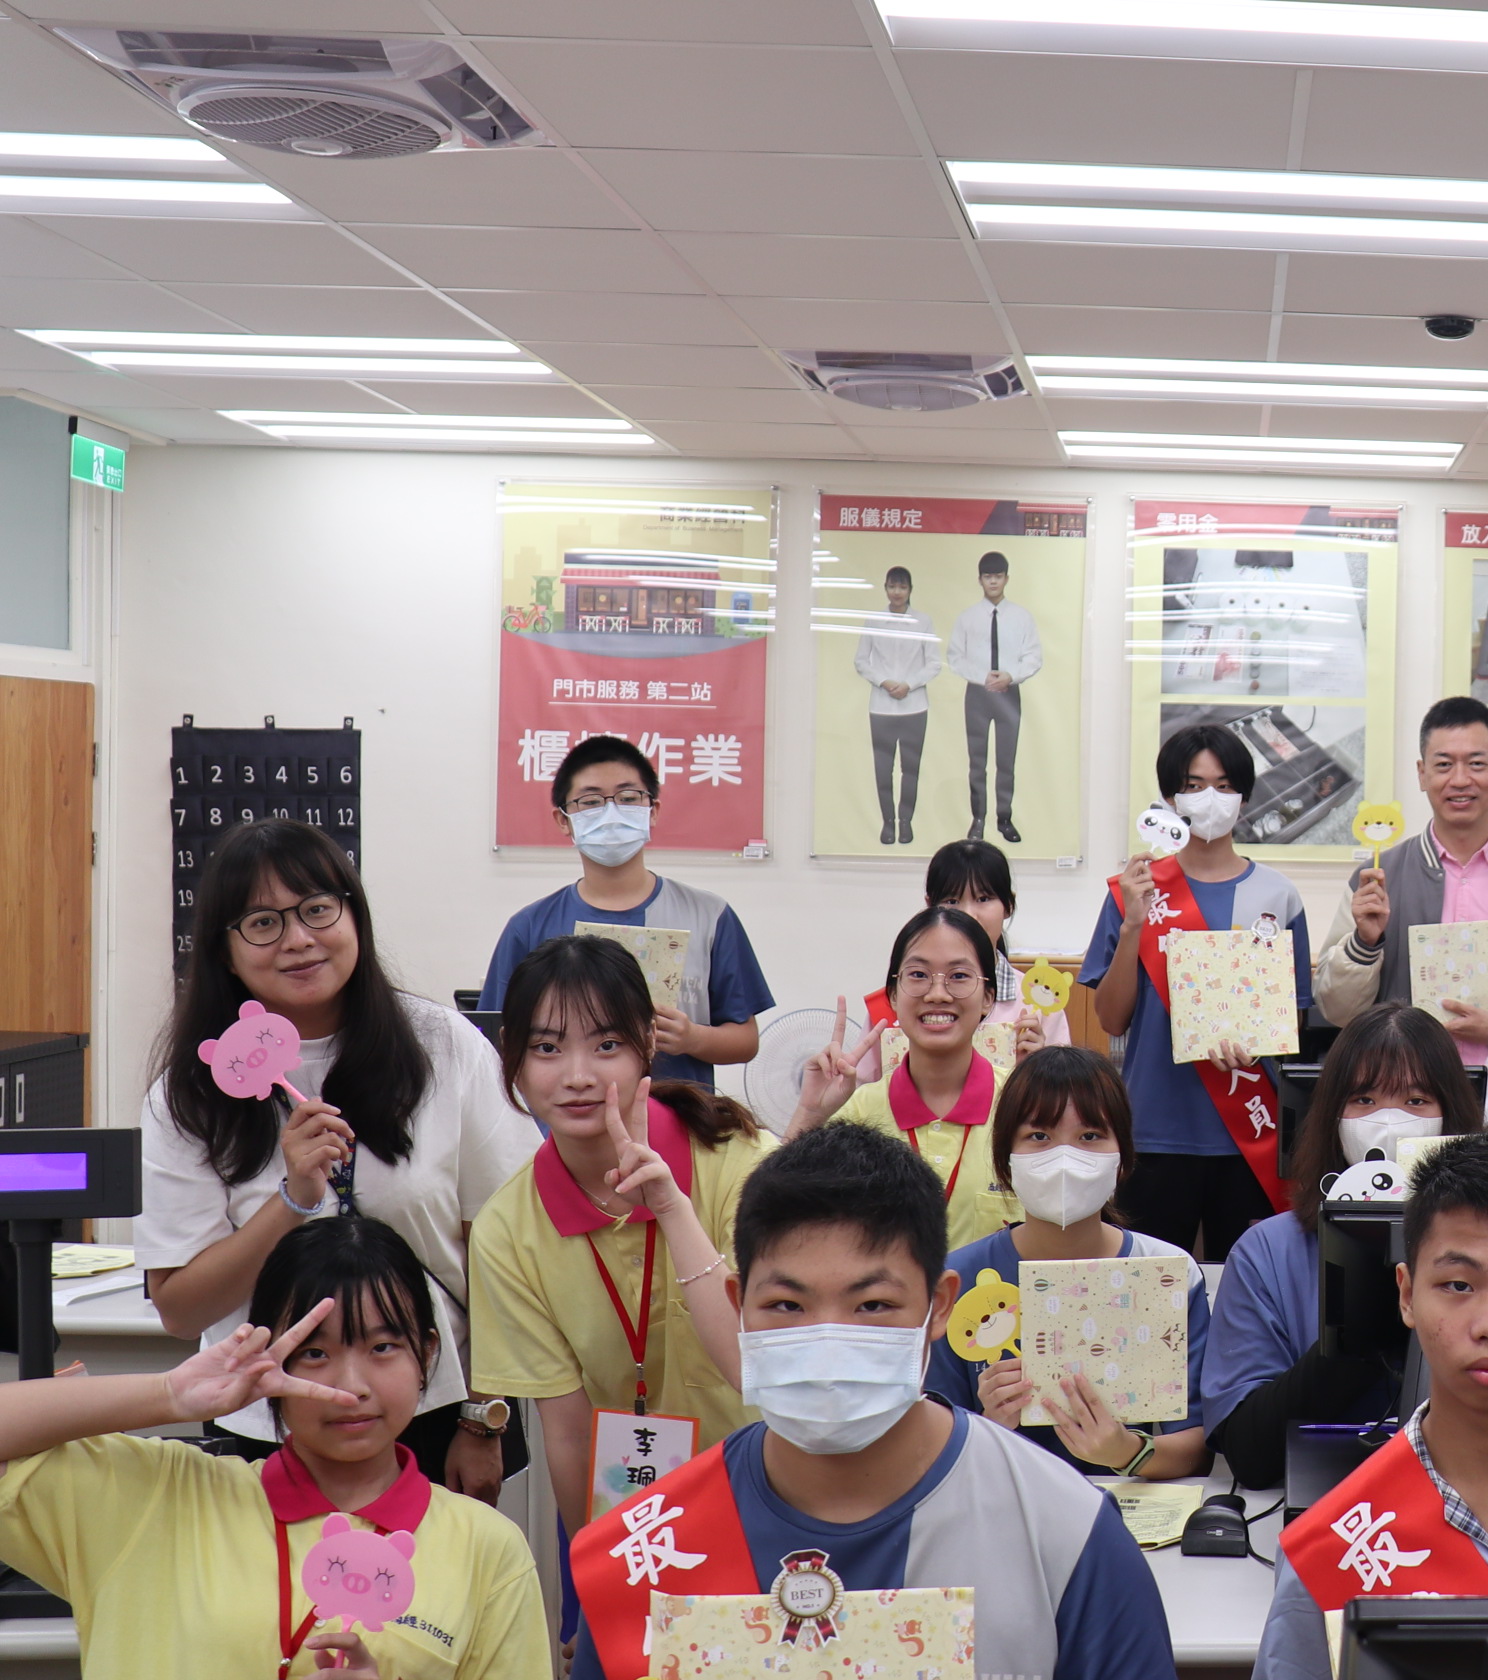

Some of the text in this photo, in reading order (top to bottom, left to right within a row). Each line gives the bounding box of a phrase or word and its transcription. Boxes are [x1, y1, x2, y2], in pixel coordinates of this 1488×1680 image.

[106, 475, 121, 486] EXIT
[839, 507, 922, 529] 服儀規定
[553, 678, 712, 701] 門市服務 第二站
[518, 729, 742, 786] 櫃作業
[176, 766, 352, 784] 1 2 3 4 5 6
[175, 809, 186, 826] 7
[210, 808, 222, 825] 8
[241, 808, 254, 824] 9
[306, 808, 322, 825] 11
[338, 808, 355, 826] 12
[178, 850, 194, 868] 13
[178, 889, 194, 906] 19
[177, 935, 193, 952] 25
[1228, 1068, 1276, 1139] 人員
[609, 1493, 708, 1586] 最
[1330, 1502, 1431, 1592] 最
[790, 1587, 825, 1601] BEST
